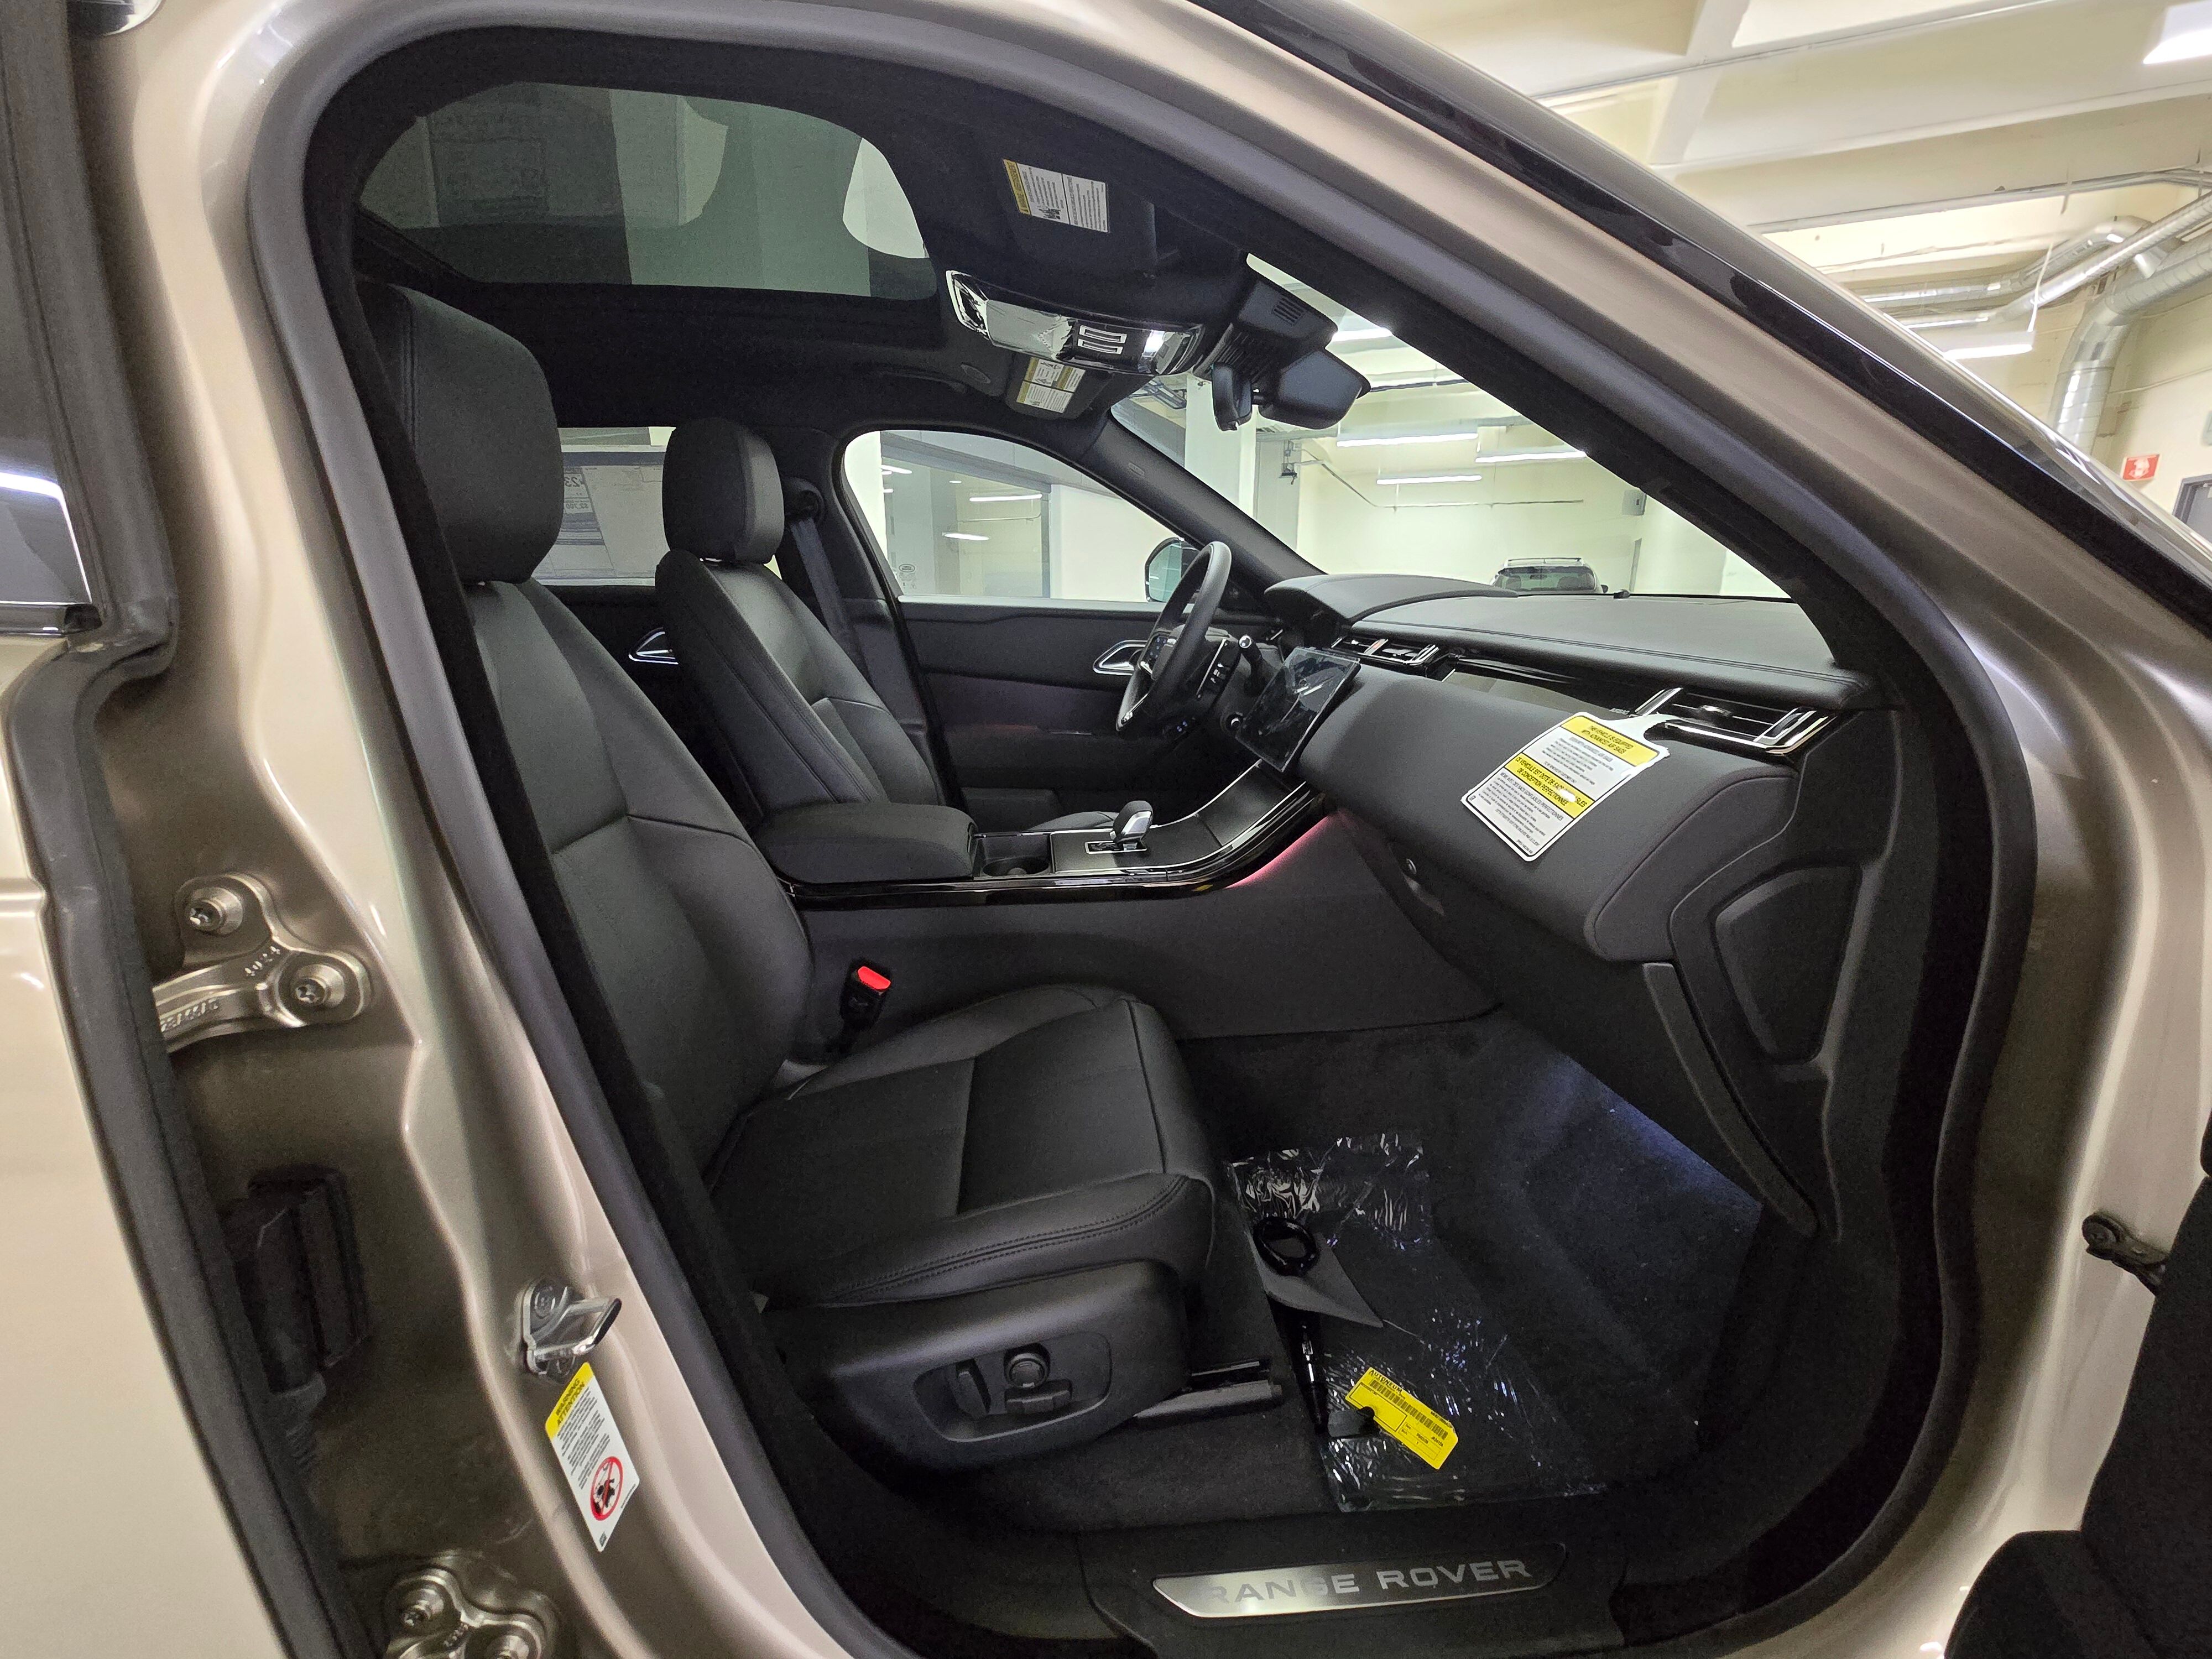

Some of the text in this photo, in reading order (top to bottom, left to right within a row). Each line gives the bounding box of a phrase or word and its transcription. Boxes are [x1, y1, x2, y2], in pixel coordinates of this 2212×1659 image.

[1520, 770, 1543, 787] CONCEPTION
[555, 1376, 580, 1416] WARNING
[1369, 1370, 1402, 1393] AUTONEUM
[556, 1380, 585, 1426] ATTENTION
[1194, 1559, 1532, 1603] RANGE ROVER
